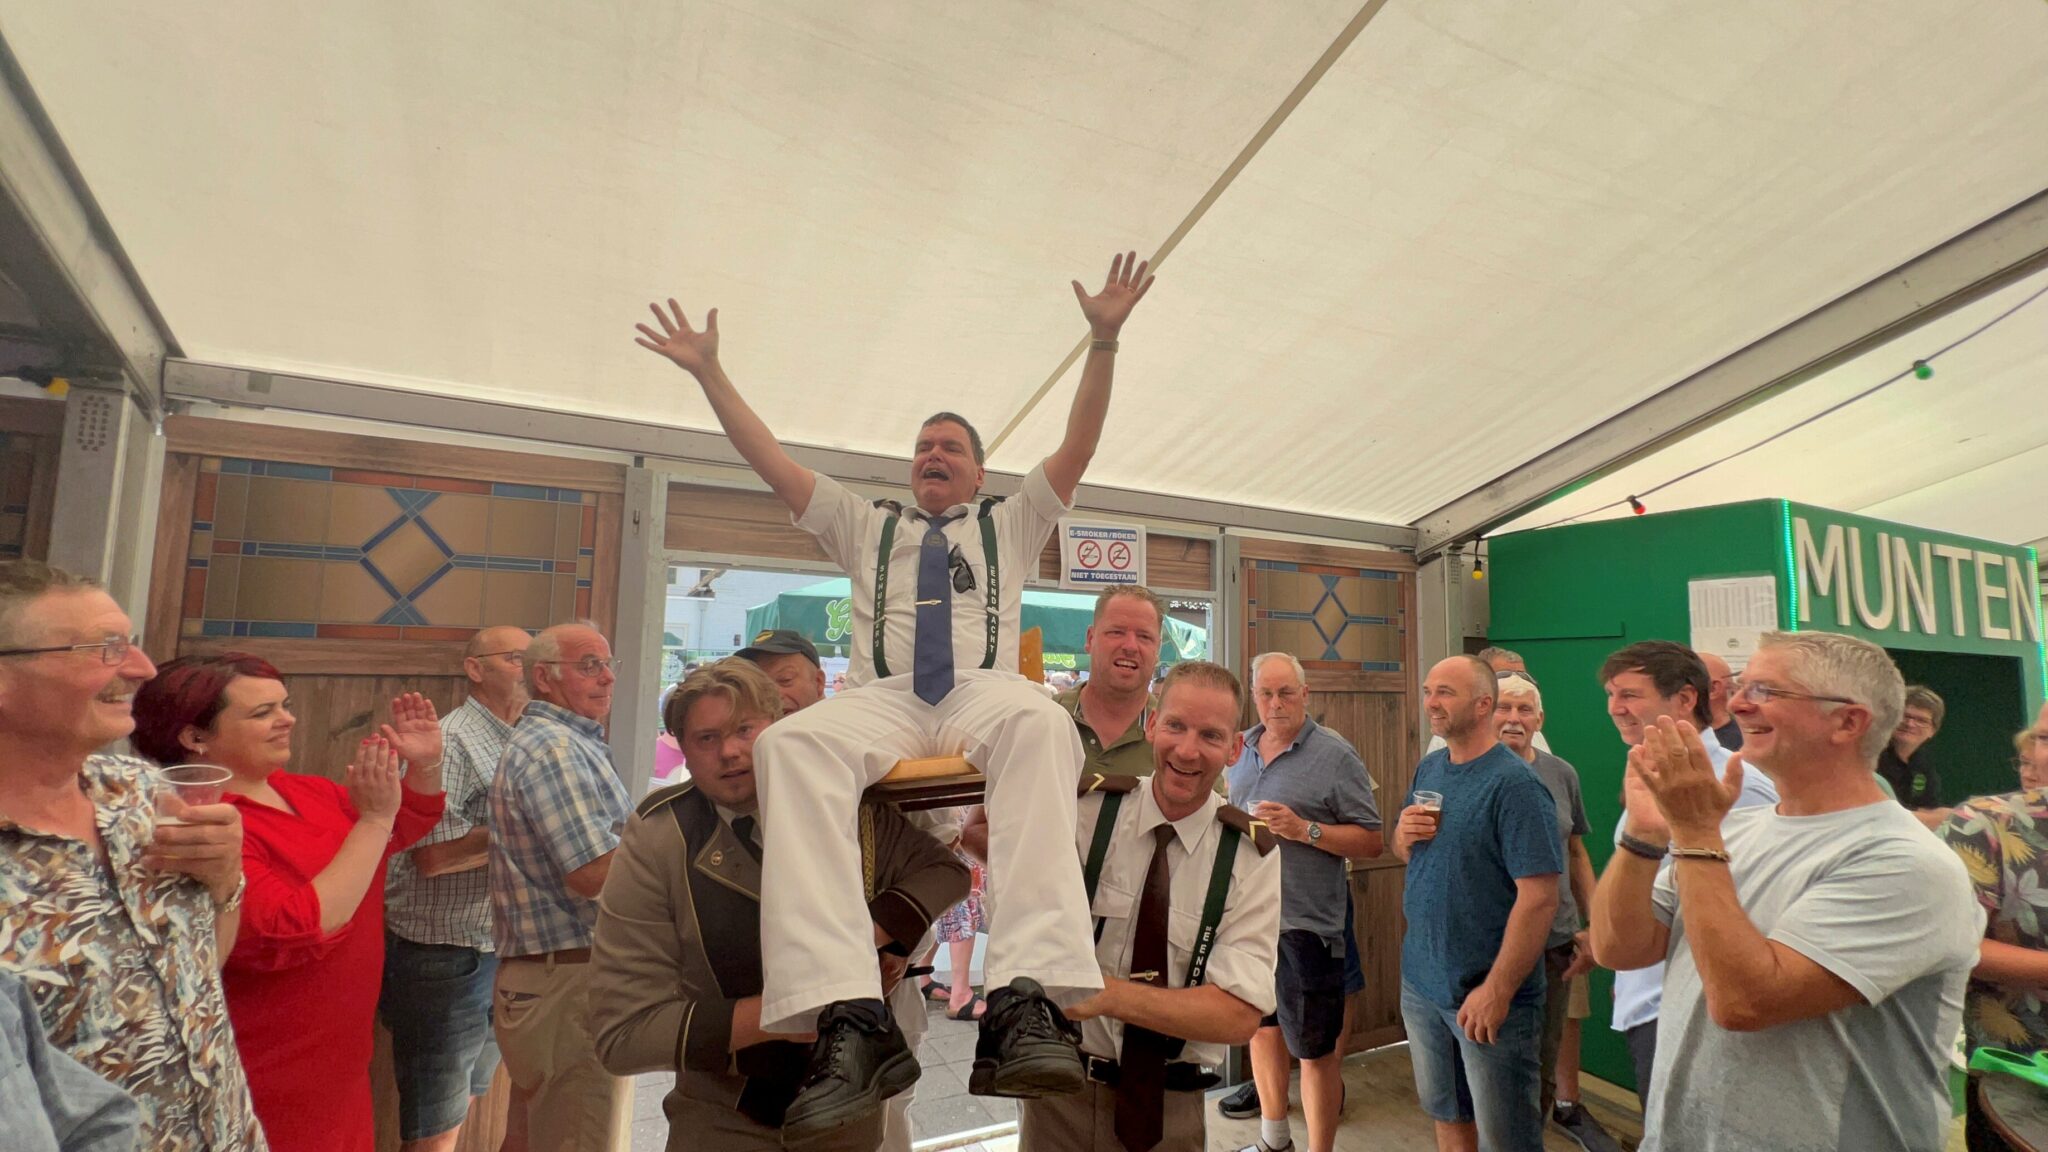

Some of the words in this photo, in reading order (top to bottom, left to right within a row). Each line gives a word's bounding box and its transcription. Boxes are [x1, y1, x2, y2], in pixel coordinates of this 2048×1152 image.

[1071, 571, 1089, 579] NIET
[1091, 572, 1137, 581] TOEGESTAAN
[1794, 517, 2039, 642] MUNTEN
[1190, 932, 1210, 986] EENDR
